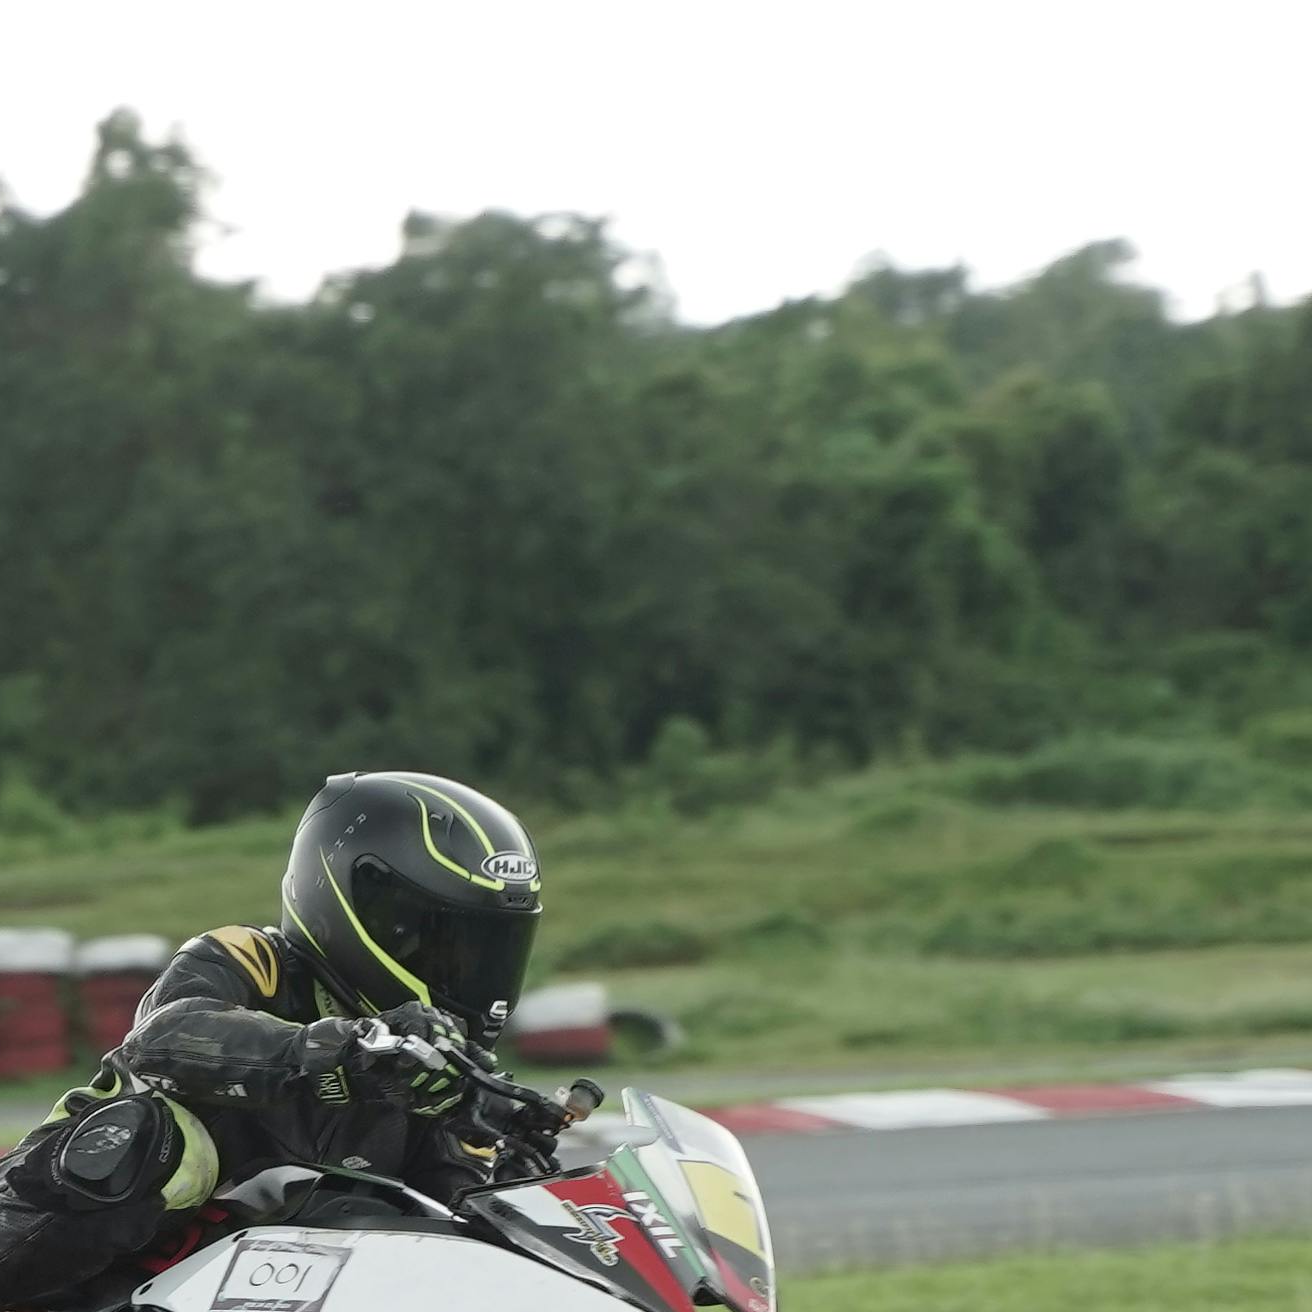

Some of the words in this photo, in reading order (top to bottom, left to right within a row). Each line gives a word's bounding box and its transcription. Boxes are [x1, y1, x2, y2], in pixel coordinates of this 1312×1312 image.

[492, 859, 535, 875] HJC
[622, 1191, 686, 1259] IXIL
[249, 1262, 313, 1293] 001
